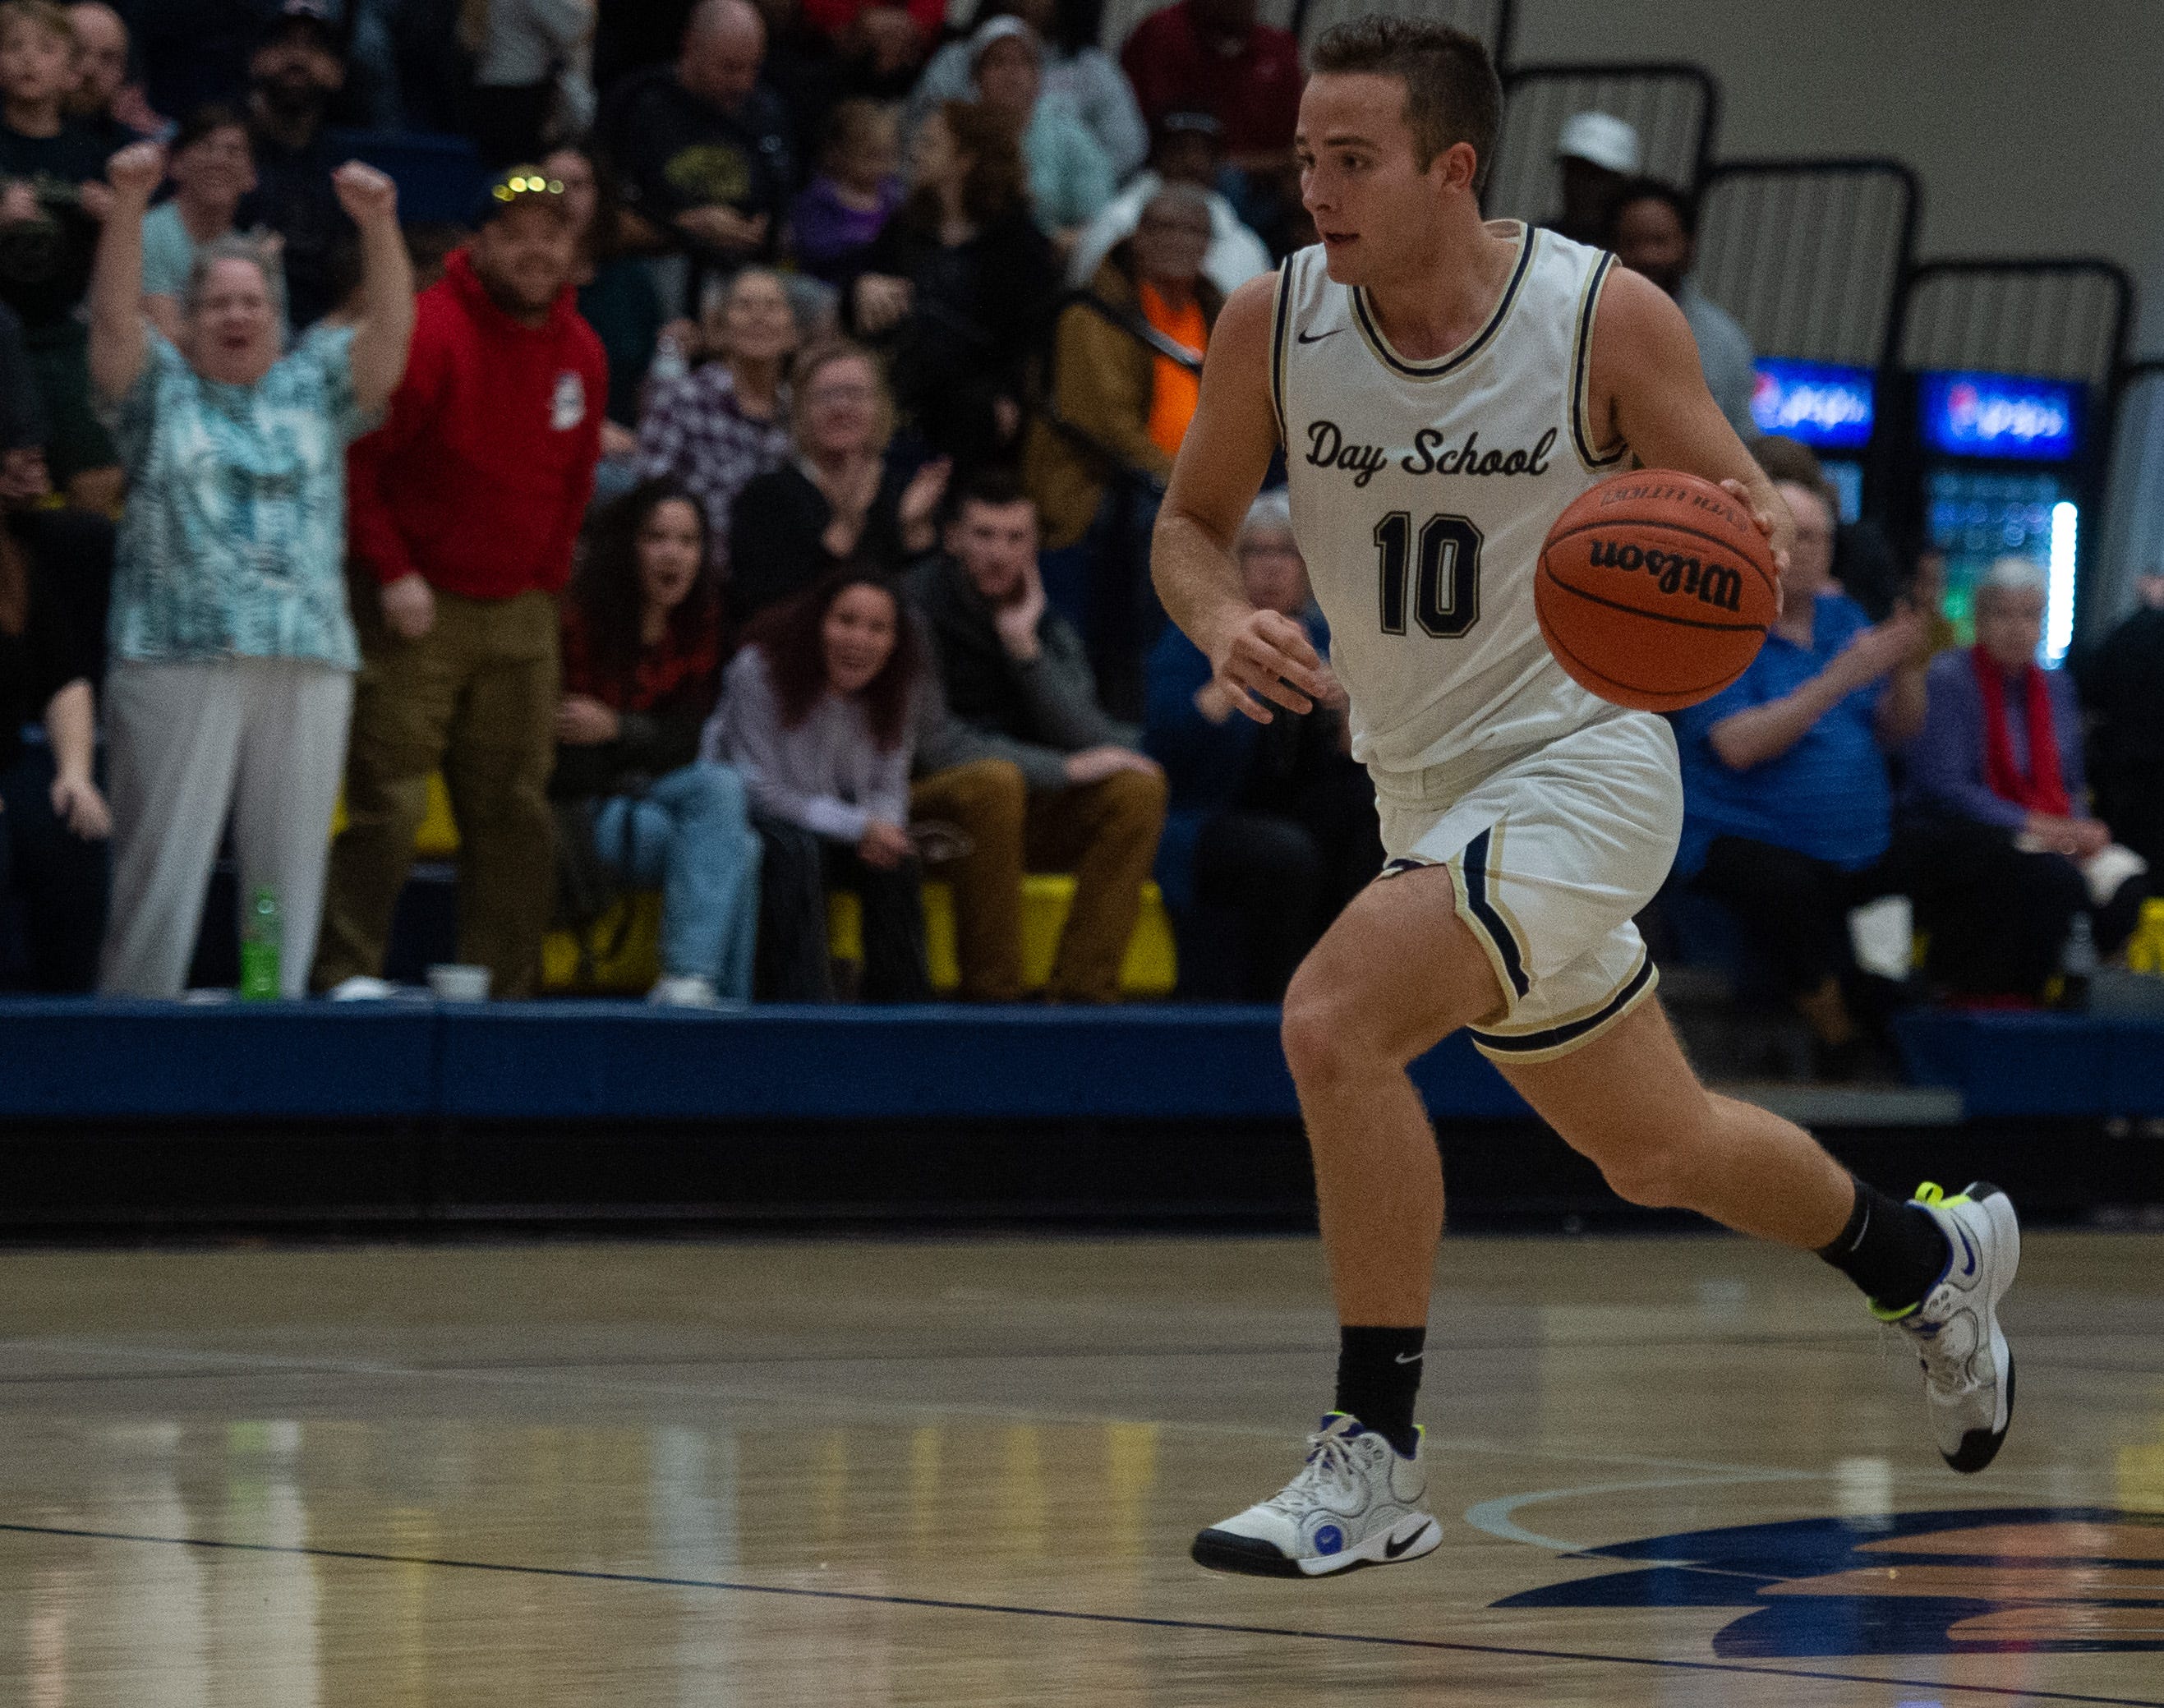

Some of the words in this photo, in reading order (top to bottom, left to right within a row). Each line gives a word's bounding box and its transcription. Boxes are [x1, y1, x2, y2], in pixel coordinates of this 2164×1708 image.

[1305, 421, 1388, 488] Day
[1401, 427, 1557, 476] School
[1374, 511, 1485, 639] 10
[1590, 538, 1743, 613] Wilson
